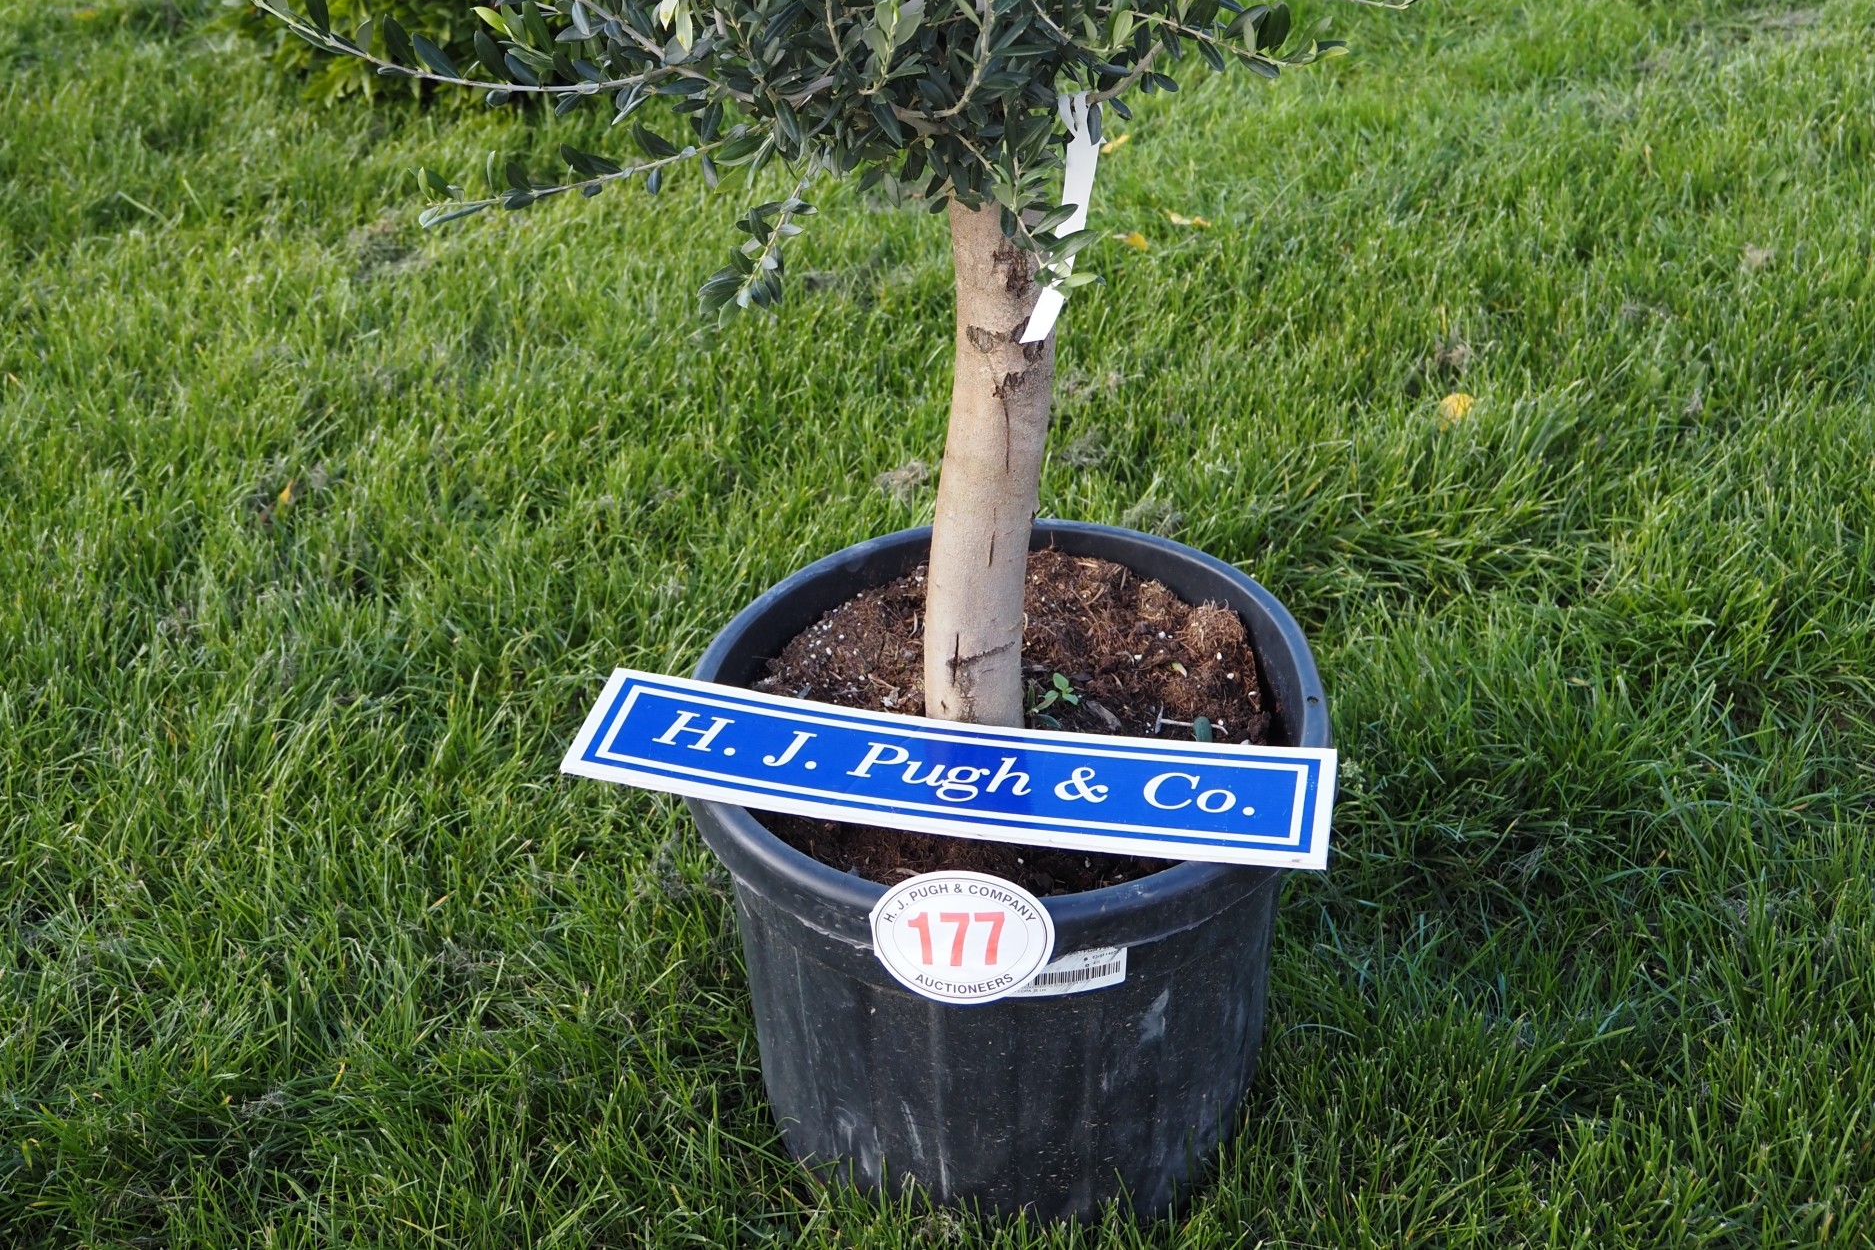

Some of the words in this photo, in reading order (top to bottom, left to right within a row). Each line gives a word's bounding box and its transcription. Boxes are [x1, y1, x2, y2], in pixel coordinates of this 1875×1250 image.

[652, 710, 736, 757] H.
[763, 731, 818, 770] J.
[846, 741, 1031, 802] Pugh
[1054, 767, 1108, 803] &
[1143, 772, 1255, 816] Co.
[883, 910, 898, 924] H.
[898, 899, 909, 911] J.
[909, 884, 948, 902] PUGH
[954, 883, 963, 894] &
[968, 884, 1037, 923] COMPANY
[908, 912, 1005, 967] 177
[915, 974, 1013, 994] AUCTIONEERS
